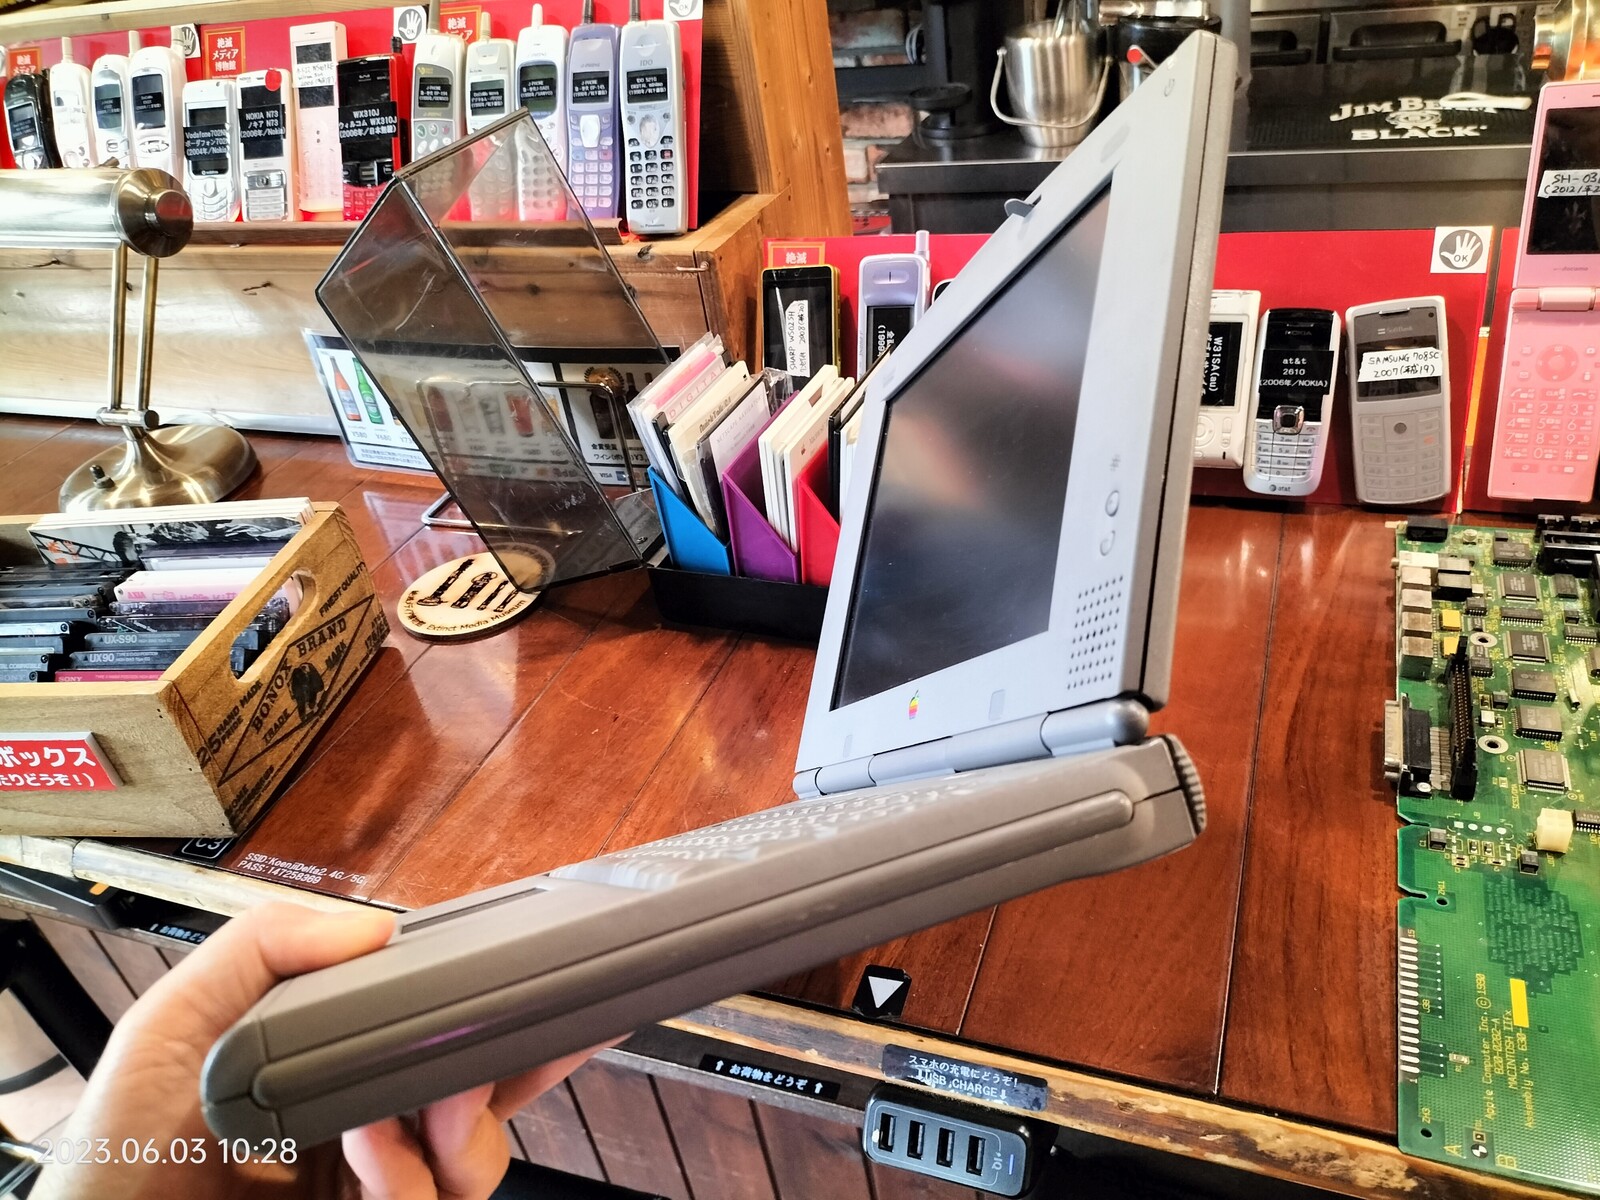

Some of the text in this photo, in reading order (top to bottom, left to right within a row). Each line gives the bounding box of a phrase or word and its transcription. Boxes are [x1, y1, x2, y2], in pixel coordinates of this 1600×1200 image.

[447, 17, 467, 29] 絶滅
[217, 37, 233, 49] 絶滅
[212, 48, 239, 60] メディア
[215, 60, 236, 71] 博物館
[640, 59, 653, 67] IDO
[246, 110, 279, 120] NOKIA N73
[353, 109, 379, 118] WX310J
[1330, 101, 1394, 121] JIM
[248, 119, 279, 129] ノキア N73
[339, 116, 397, 129] ウィルコム WX310J
[1351, 125, 1482, 141] BLACK
[1552, 172, 1600, 185] SH-03
[785, 252, 807, 264] 絶滅
[1453, 254, 1468, 263] OK
[877, 325, 886, 354] (1999
[789, 346, 797, 370] SHARP
[1208, 336, 1223, 392] W31SA(au)
[1282, 357, 1307, 365] at&t
[1368, 351, 1440, 365] SAMSUNG 708SC
[1282, 368, 1306, 376] 2610
[1259, 379, 1328, 388] (2006年/NOKIA)
[319, 586, 342, 617] FINEST
[460, 619, 489, 630] Media
[490, 599, 527, 621] Museum
[104, 634, 138, 644] UX-S90
[89, 653, 115, 663] UX90
[251, 658, 294, 734] BONOX
[296, 617, 347, 658] BRAND
[216, 680, 263, 735] HAND MADE
[262, 708, 291, 746] TRADE
[0, 745, 97, 768] ボックス
[1476, 973, 1486, 995] 1990
[1479, 1011, 1489, 1033] Inc.
[1503, 1009, 1518, 1090] MACINTOSH IIfx
[1481, 1038, 1493, 1084] Computer
[1520, 1057, 1530, 1074] No.
[729, 1063, 809, 1091] お荷物をどうぞ
[908, 1054, 1019, 1088] スマホの充電にどうぞ!
[925, 1069, 998, 1098] USB CHARGE
[1484, 1089, 1499, 1120] Apple
[1520, 1079, 1535, 1129] Assembly
